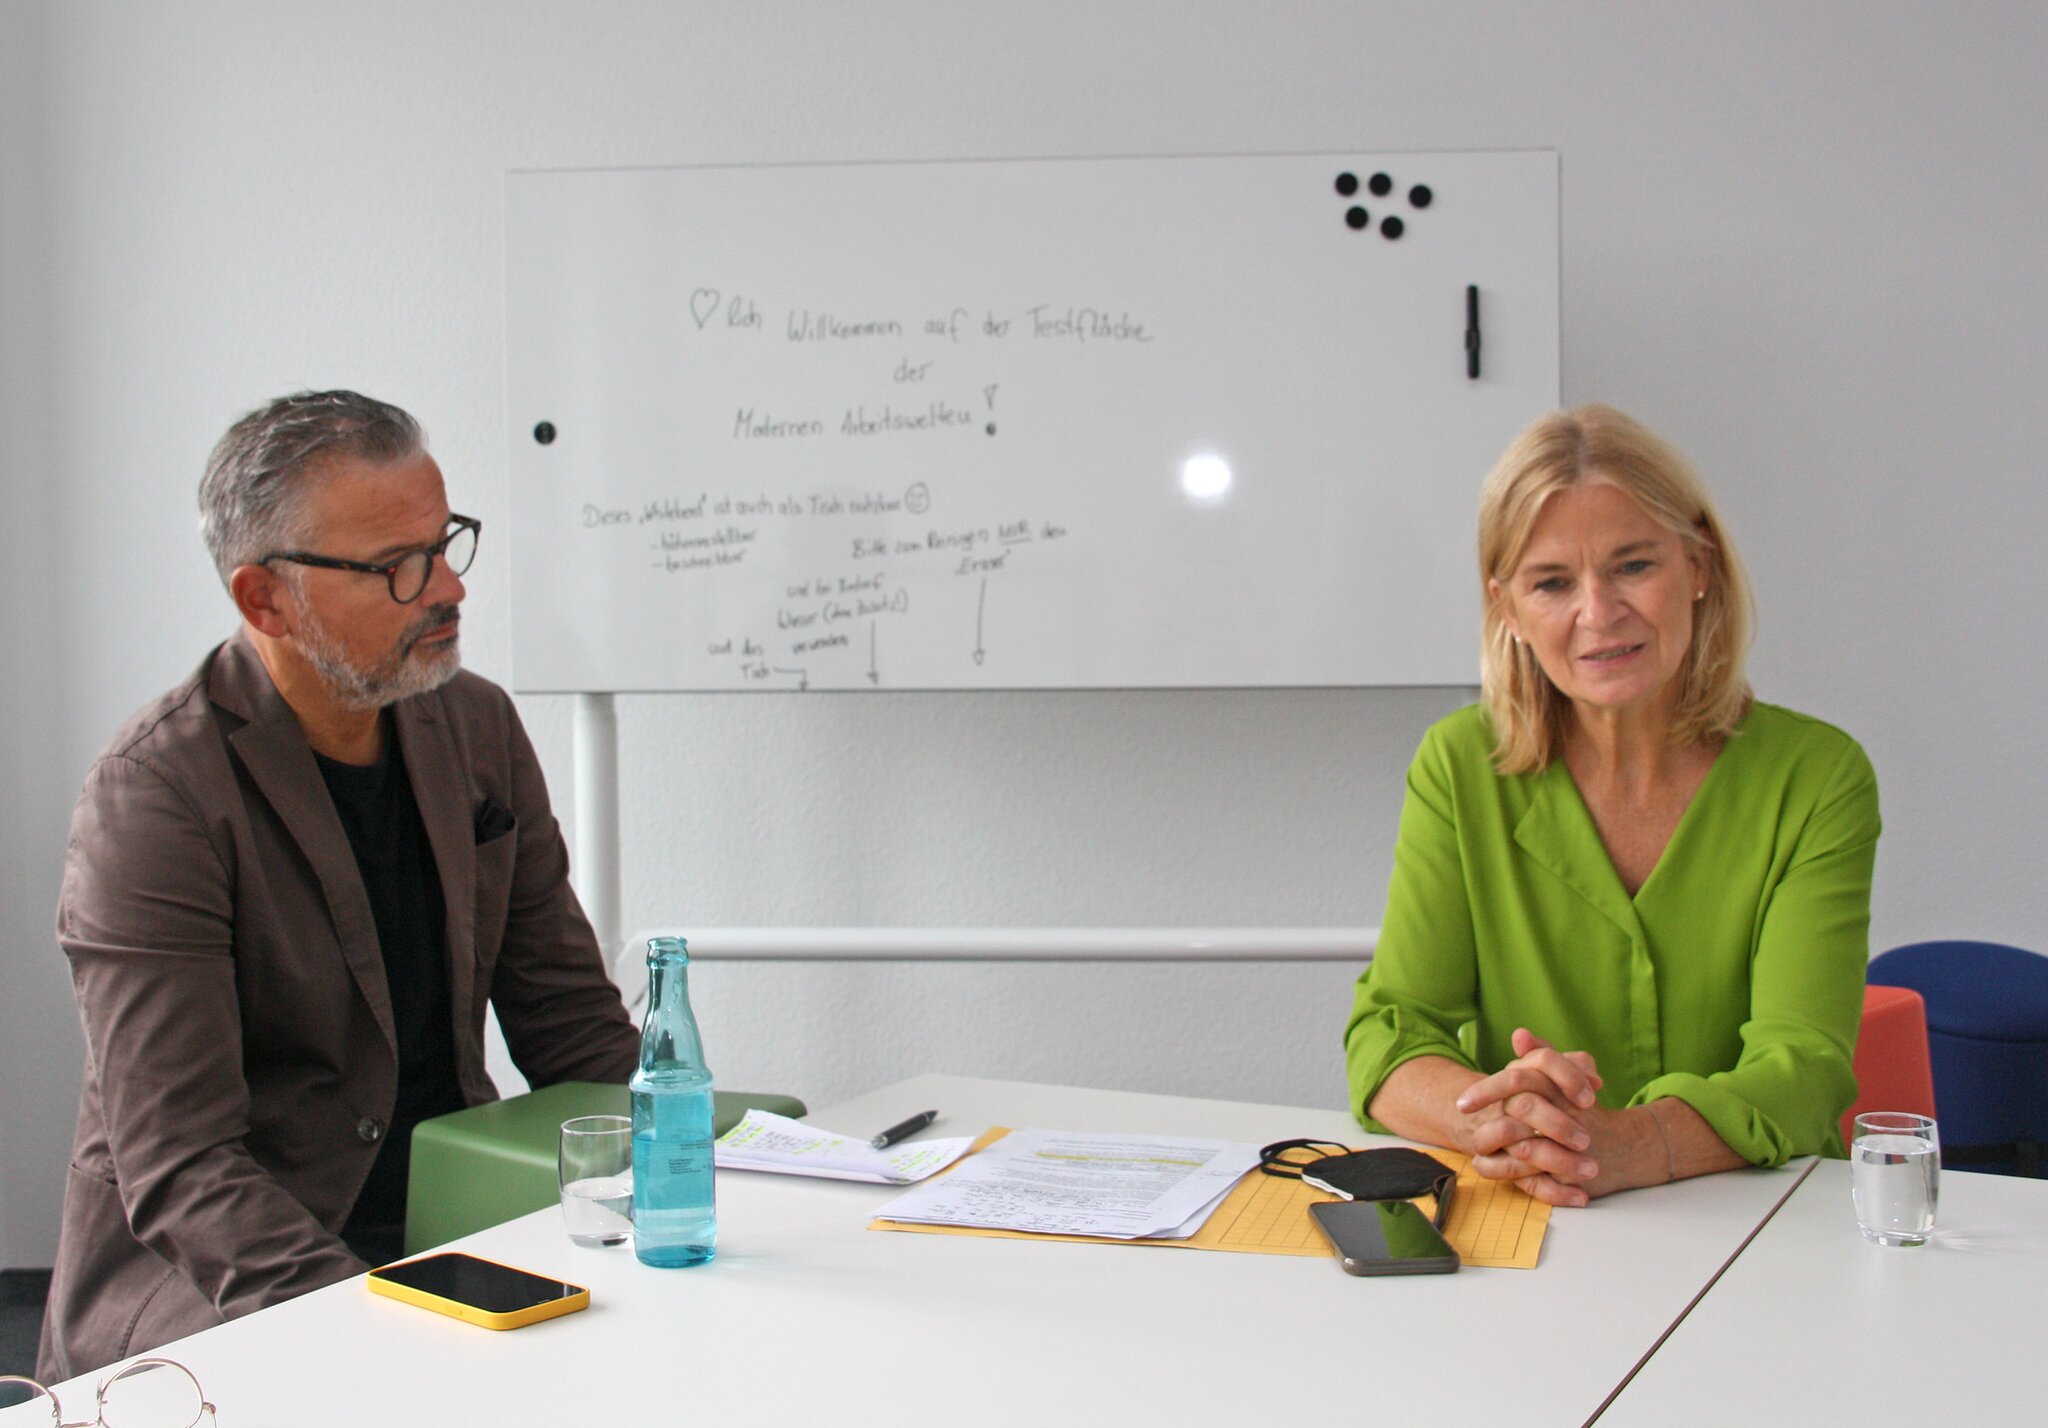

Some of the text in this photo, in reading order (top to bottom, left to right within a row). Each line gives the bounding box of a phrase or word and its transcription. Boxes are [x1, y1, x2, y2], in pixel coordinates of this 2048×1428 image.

[787, 309, 902, 342] Willkommen
[924, 307, 969, 343] auf
[983, 310, 1012, 338] der
[1025, 303, 1155, 343] Testfläche
[893, 356, 934, 384] der
[733, 406, 823, 439] Modernen
[582, 503, 632, 529] Dieses
[714, 494, 731, 516] ist
[736, 492, 773, 515] auch
[778, 494, 803, 516] als
[808, 493, 845, 516] Tisch
[849, 491, 901, 516] nutzbar
[852, 519, 1067, 559] Bitte zum Reinigen NUR den
[786, 580, 809, 598] und
[839, 572, 886, 594] Bedarf
[777, 609, 819, 630] Wasser
[708, 638, 732, 656] und
[792, 633, 849, 656] verwenden
